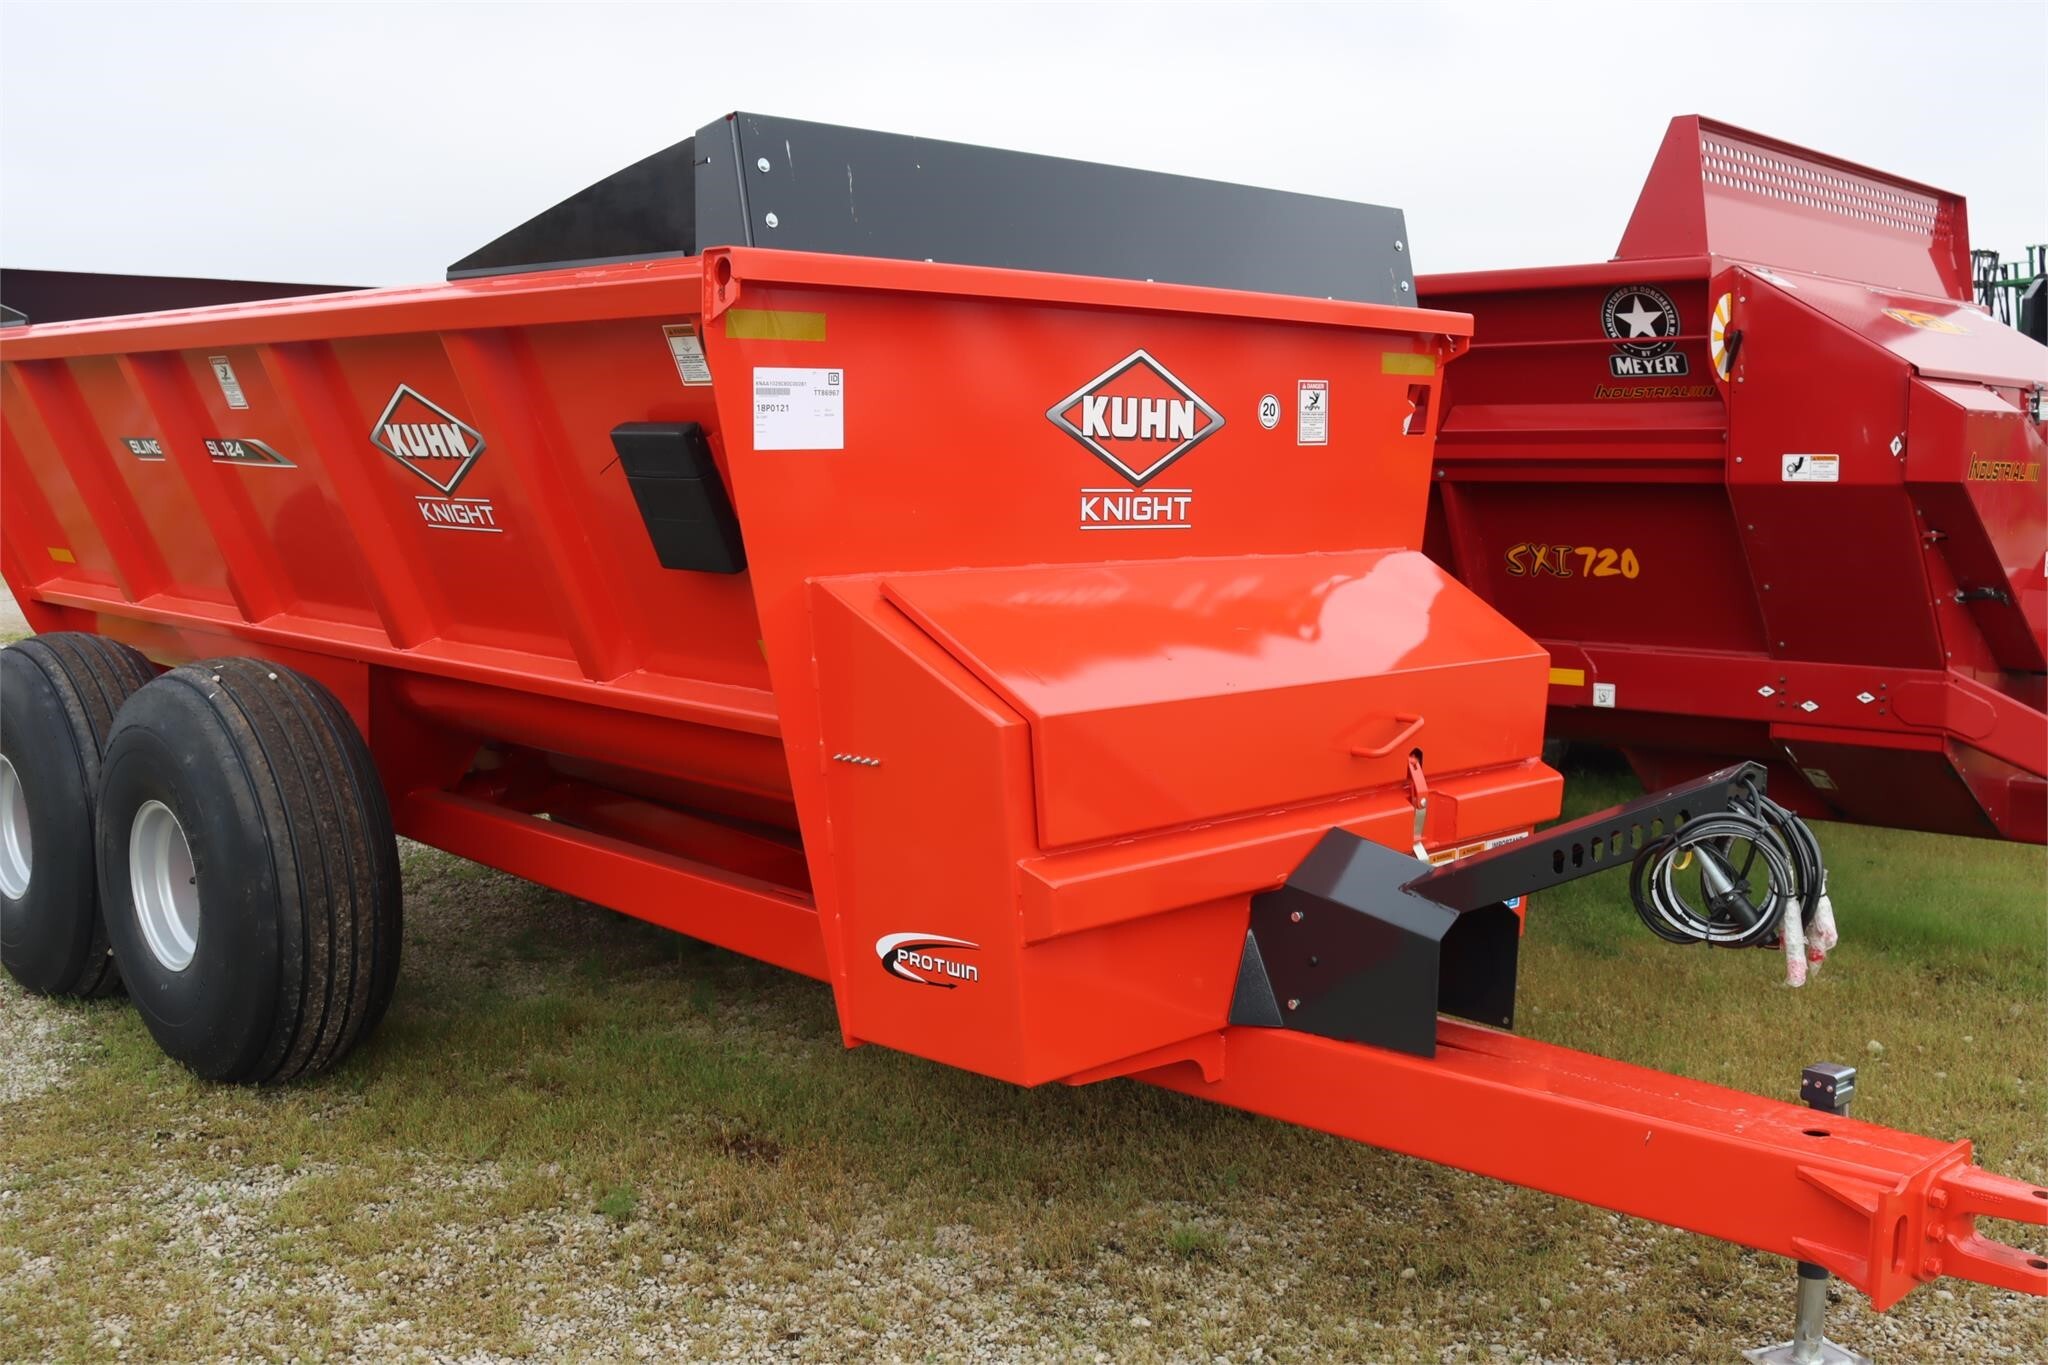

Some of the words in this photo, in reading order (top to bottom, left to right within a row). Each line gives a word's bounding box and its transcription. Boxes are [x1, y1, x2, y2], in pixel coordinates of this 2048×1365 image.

[1615, 355, 1679, 375] MEYER
[1081, 395, 1195, 441] KUHN
[1262, 402, 1276, 417] 20
[383, 423, 471, 458] KUHN
[418, 501, 495, 526] KNIGHT
[1080, 496, 1192, 521] KNIGHT
[1574, 546, 1640, 579] 720
[897, 948, 979, 982] PROTWIN
